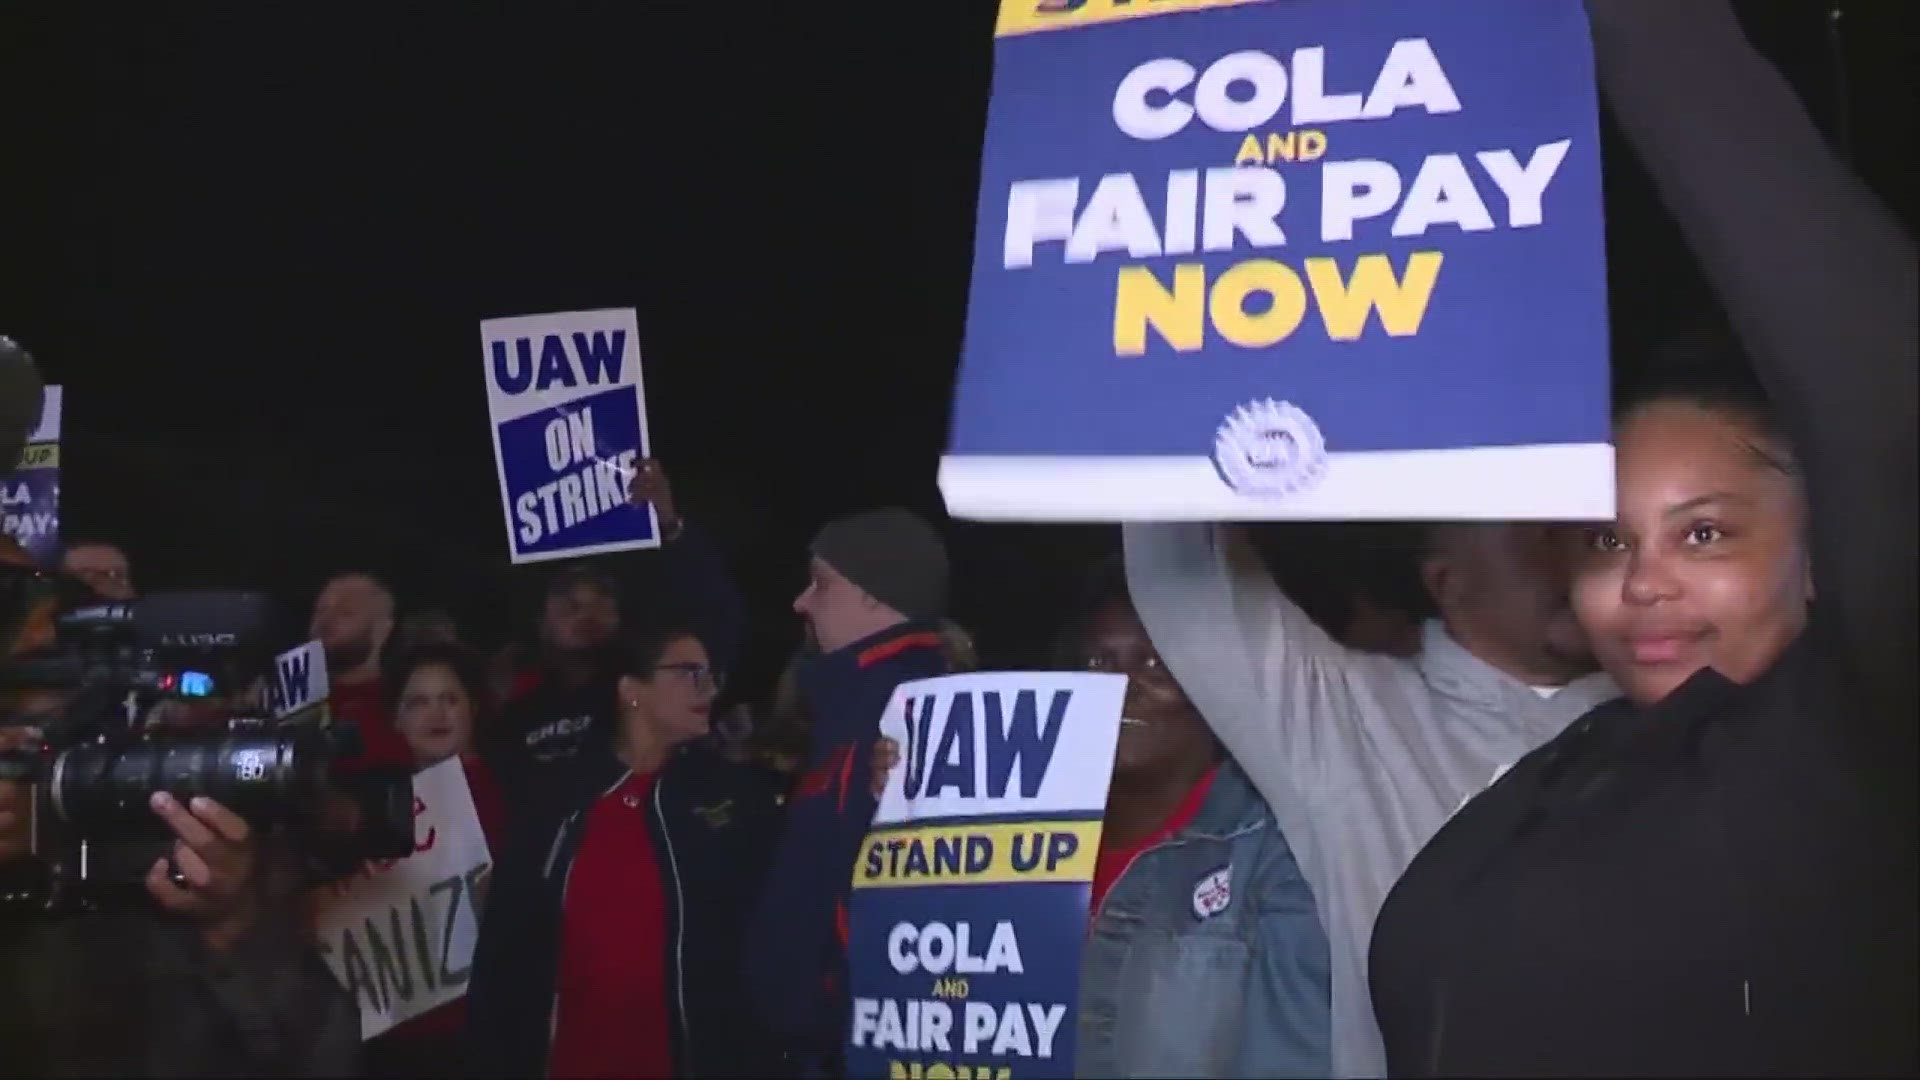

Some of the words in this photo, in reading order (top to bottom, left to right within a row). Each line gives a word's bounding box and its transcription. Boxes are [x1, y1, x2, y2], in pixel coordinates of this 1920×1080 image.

[1112, 37, 1461, 140] COLA
[1235, 130, 1328, 168] AND
[1004, 165, 1287, 270] FAIR
[1321, 139, 1571, 243] PAY
[1113, 251, 1443, 357] NOW
[492, 329, 626, 395] UAW
[545, 405, 596, 472] ON
[516, 449, 637, 546] STRIKE
[903, 689, 1073, 800] UAW
[864, 834, 994, 878] STAND
[1010, 832, 1079, 872] UP
[888, 920, 1024, 974] COLA
[932, 978, 969, 998] AND
[852, 998, 953, 1053] FAIR
[963, 1001, 1067, 1058] PAY
